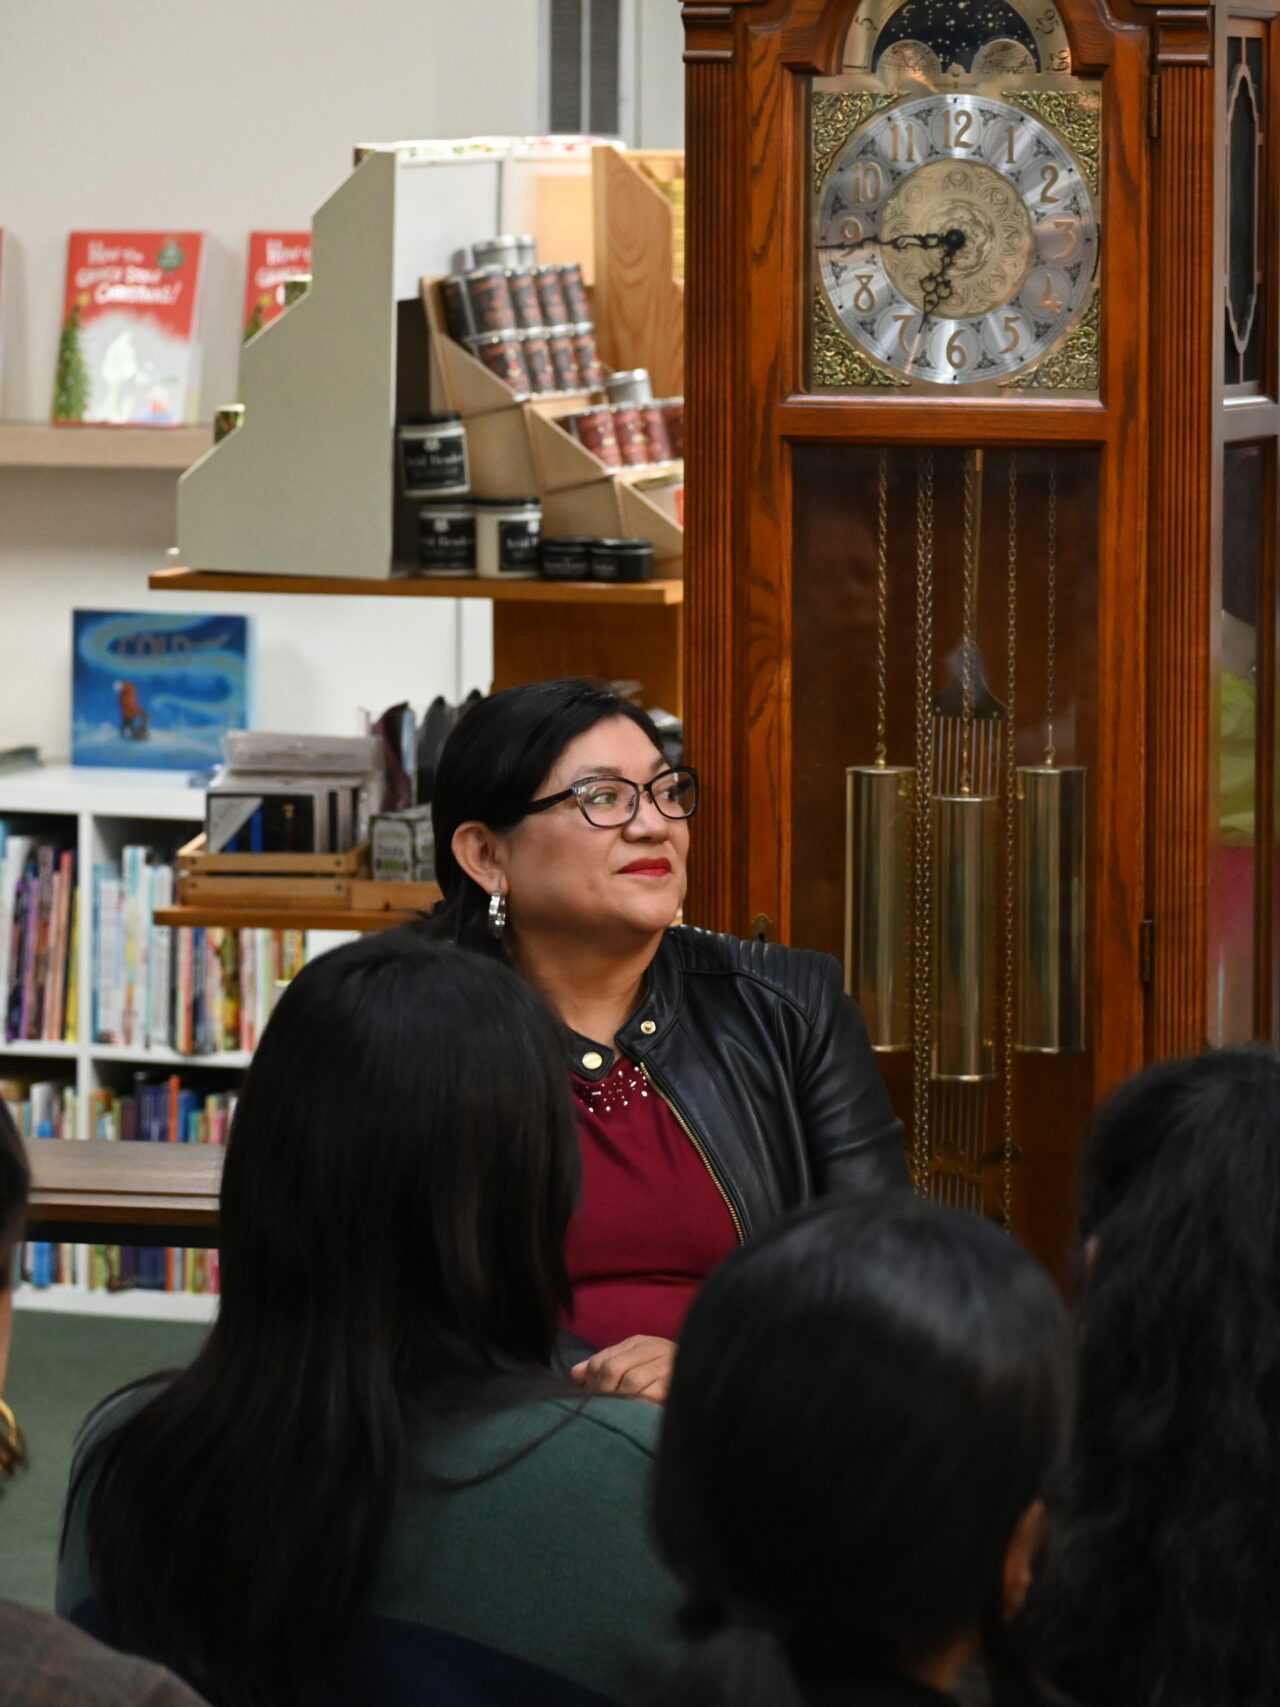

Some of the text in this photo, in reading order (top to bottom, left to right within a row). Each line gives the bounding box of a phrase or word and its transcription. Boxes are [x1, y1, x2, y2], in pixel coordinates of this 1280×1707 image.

[889, 123, 918, 163] 11
[942, 110, 974, 149] 12
[1005, 124, 1016, 164] 1
[851, 162, 883, 204] 10
[1039, 164, 1060, 203] 2
[840, 217, 863, 258] 9
[1053, 220, 1077, 260] 3
[854, 274, 877, 313] 8
[1035, 274, 1064, 314] 4
[892, 313, 915, 352] 7
[945, 328, 968, 370] 6
[1000, 315, 1021, 355] 5
